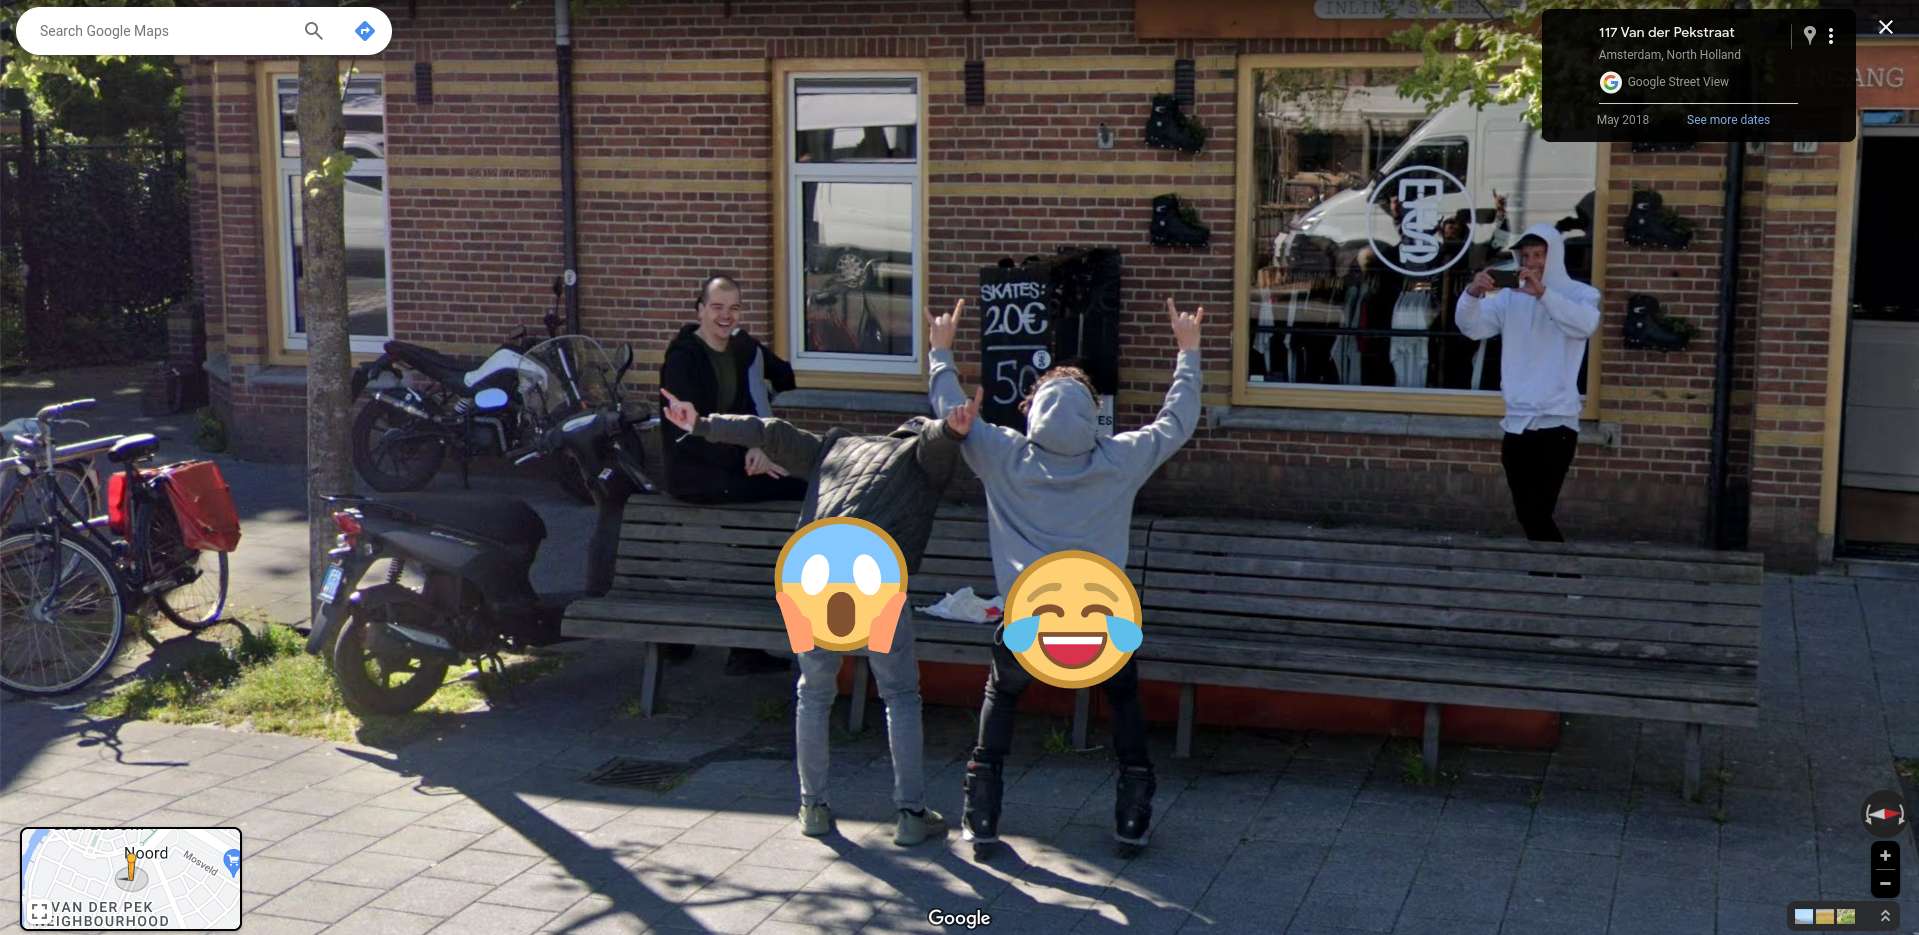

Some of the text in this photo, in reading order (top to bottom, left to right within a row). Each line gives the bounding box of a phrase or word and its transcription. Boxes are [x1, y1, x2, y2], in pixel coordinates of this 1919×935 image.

[1327, 0, 1386, 14] INLIN
[980, 282, 1047, 302] SKATES:
[984, 301, 1049, 336] 20€
[1096, 415, 1113, 426] ES
